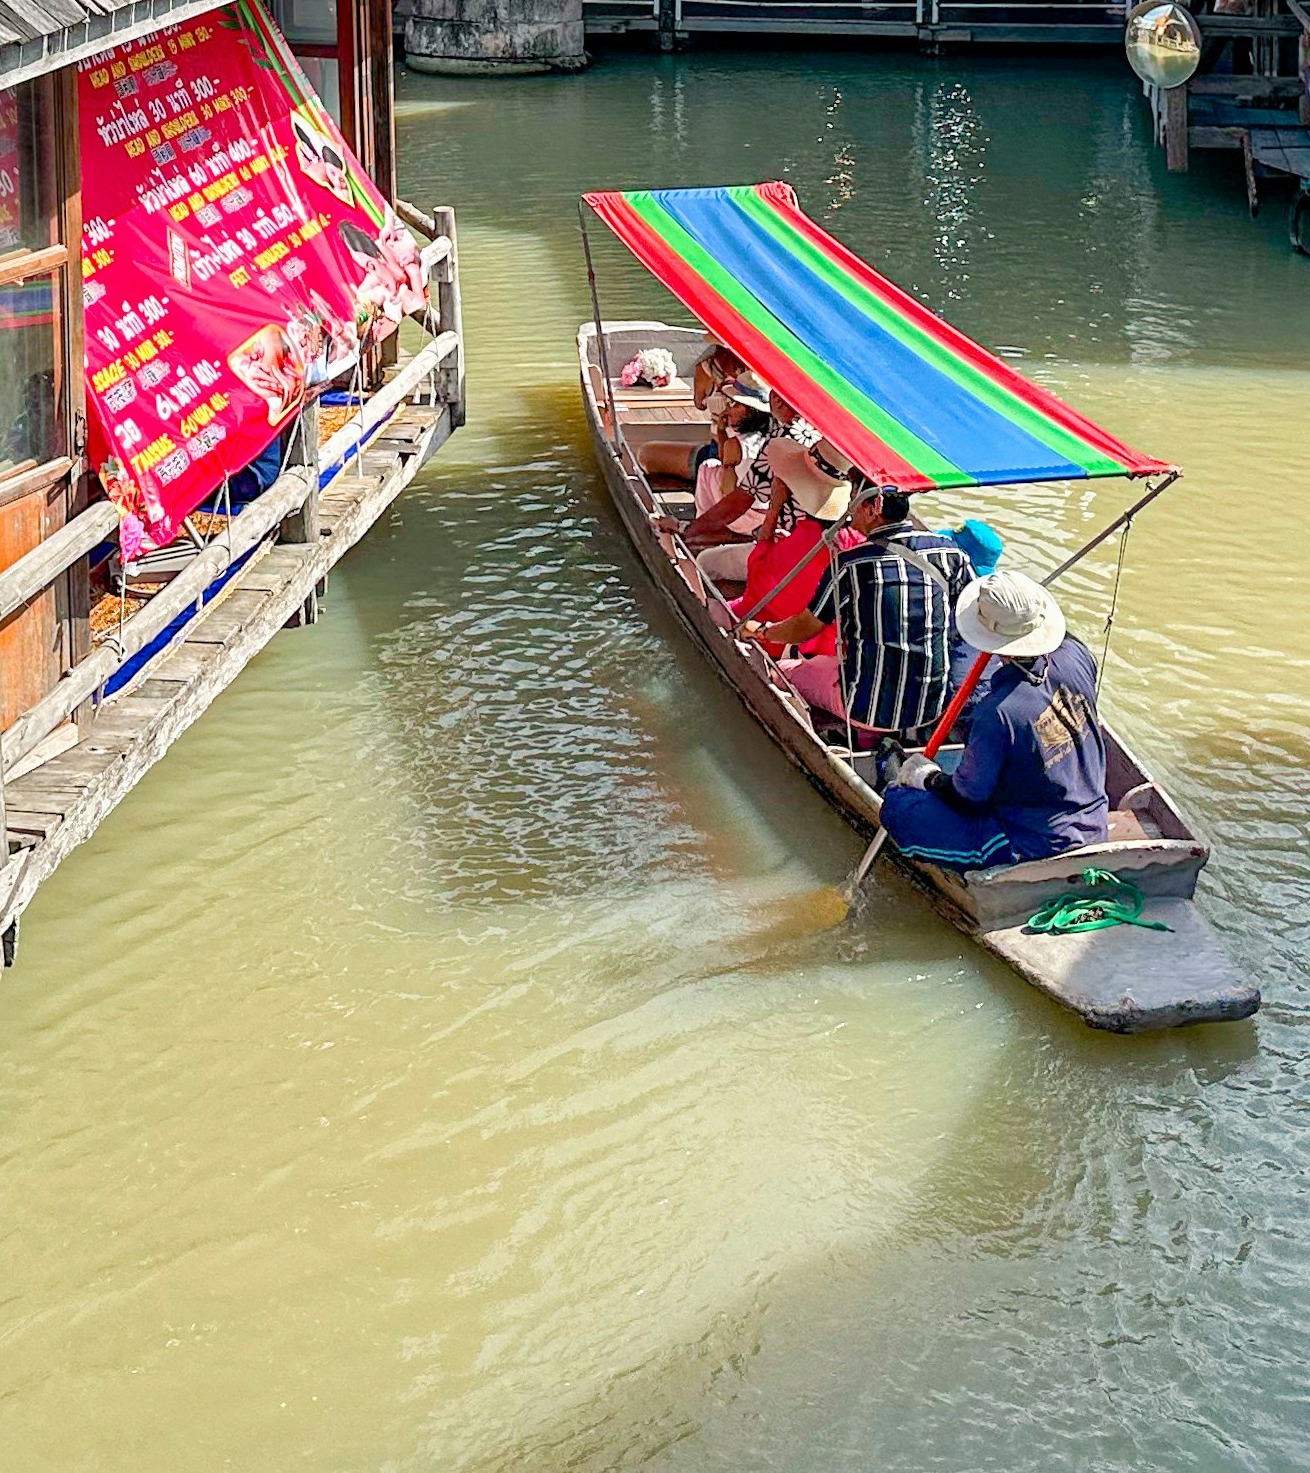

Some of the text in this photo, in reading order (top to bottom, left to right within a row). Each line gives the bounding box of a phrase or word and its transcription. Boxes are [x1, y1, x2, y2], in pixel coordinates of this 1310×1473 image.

[148, 97, 167, 123] 30
[165, 78, 193, 114] นาที
[190, 75, 221, 102] 300.-
[124, 137, 146, 159] HEAD
[145, 129, 162, 148] AND
[200, 104, 214, 121] 30
[187, 162, 208, 186] 60
[228, 137, 258, 163] 400.-
[83, 216, 116, 246] 300.-
[236, 227, 258, 250] 30
[287, 231, 302, 249] 30
[97, 326, 121, 352] 30
[138, 295, 170, 325] 300.-
[123, 351, 141, 372] 30
[180, 415, 199, 439] 60
